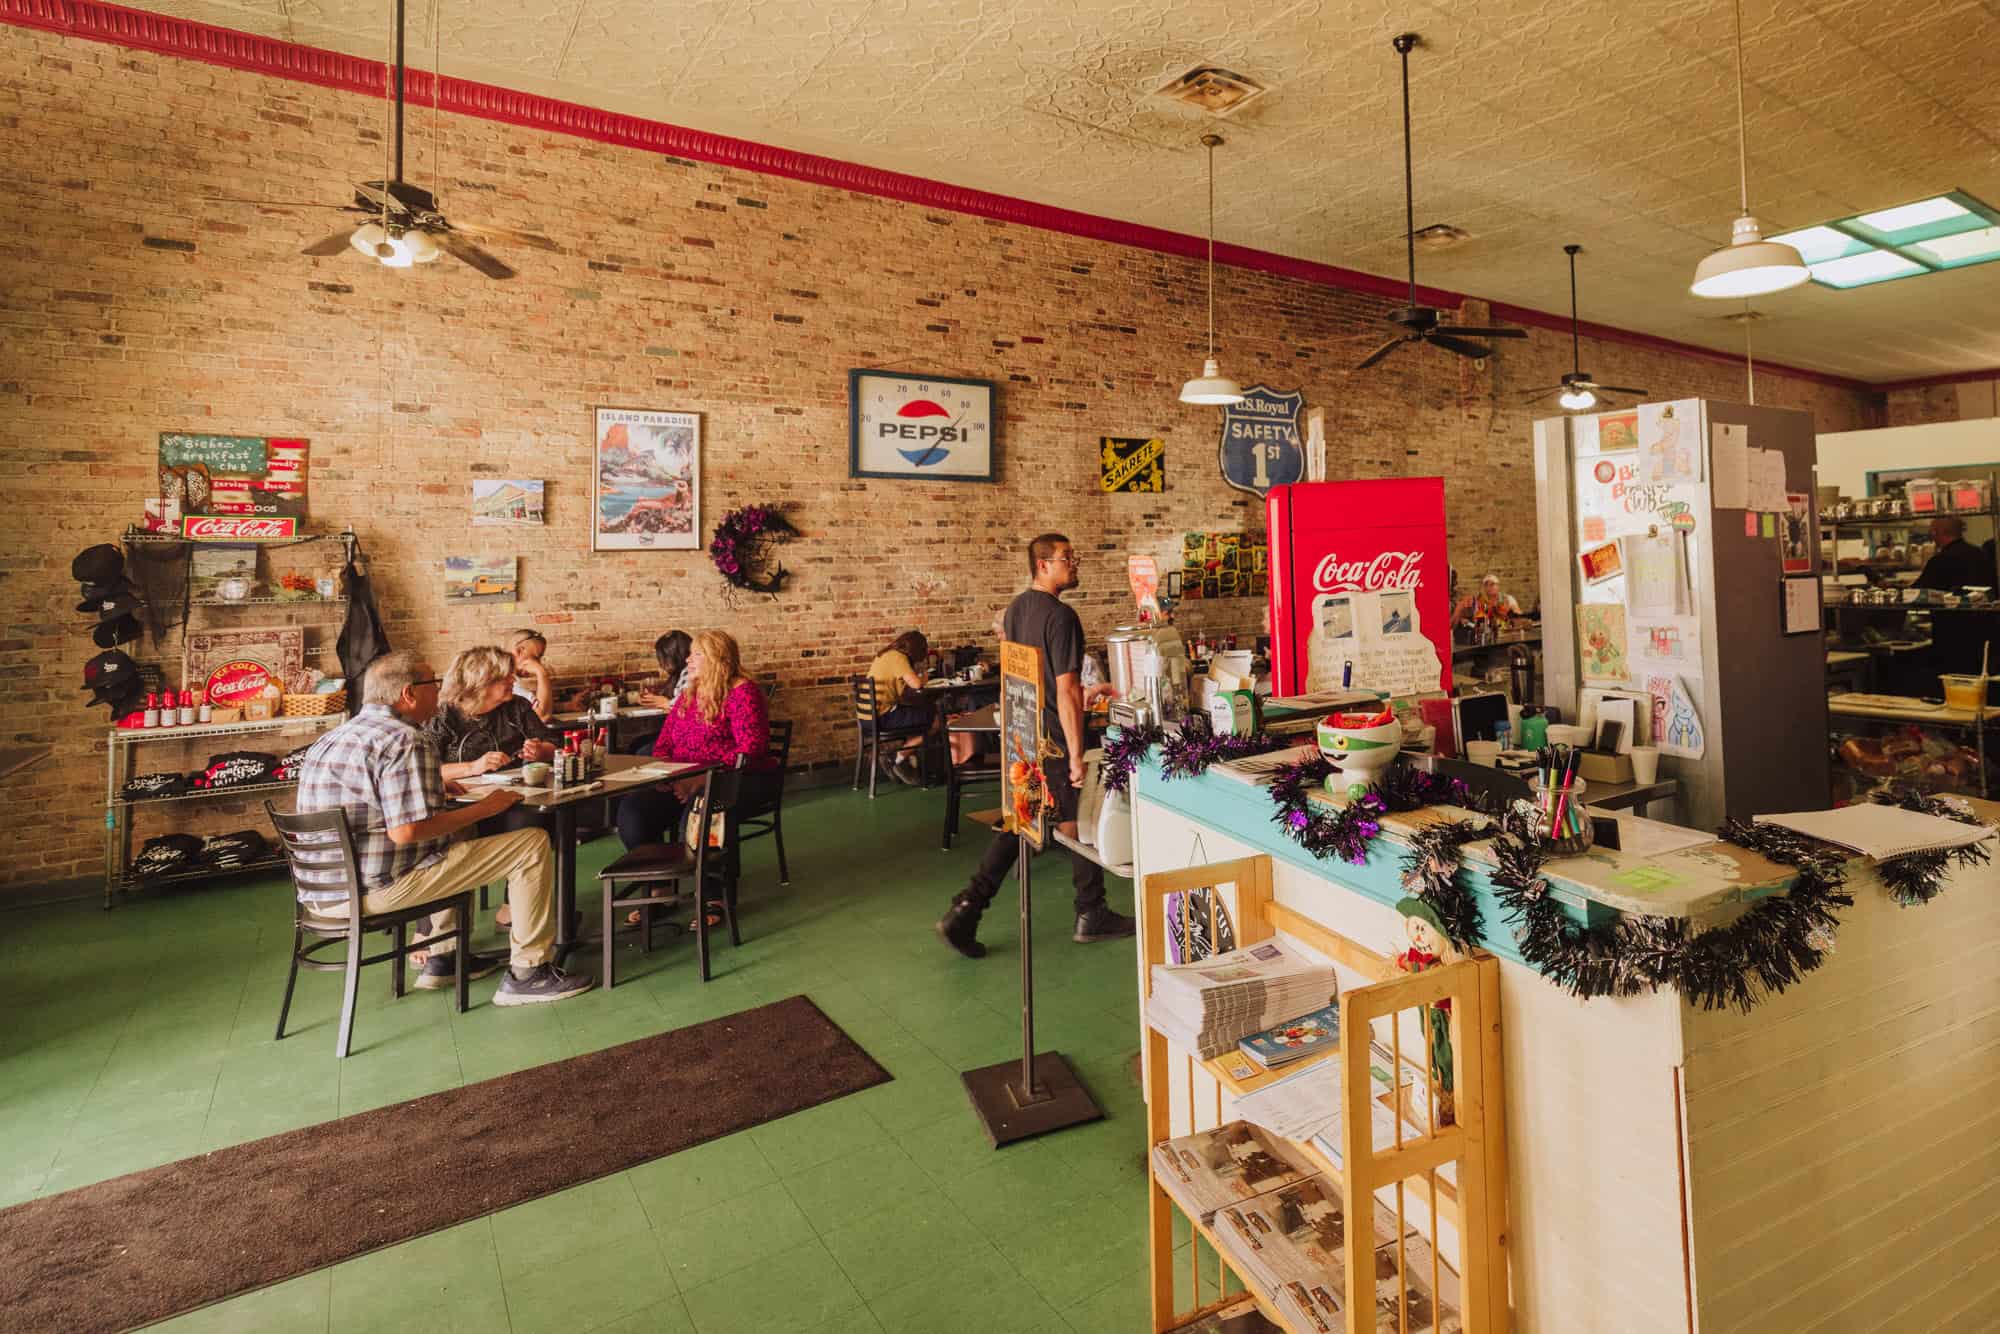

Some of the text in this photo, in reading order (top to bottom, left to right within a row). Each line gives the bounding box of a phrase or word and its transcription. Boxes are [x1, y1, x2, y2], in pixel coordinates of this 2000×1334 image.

[918, 384, 929, 393] 40
[1256, 399, 1289, 416] Royal
[601, 413, 693, 425] ISLAND PARADISE
[879, 423, 968, 442] PEPSI
[1231, 422, 1292, 440] SAFETY
[244, 504, 278, 513] 2005
[190, 518, 287, 537] Coca-Cola
[1313, 551, 1424, 592] Coca-Cola
[230, 663, 258, 672] COLD
[210, 672, 267, 698] Coca-Cola
